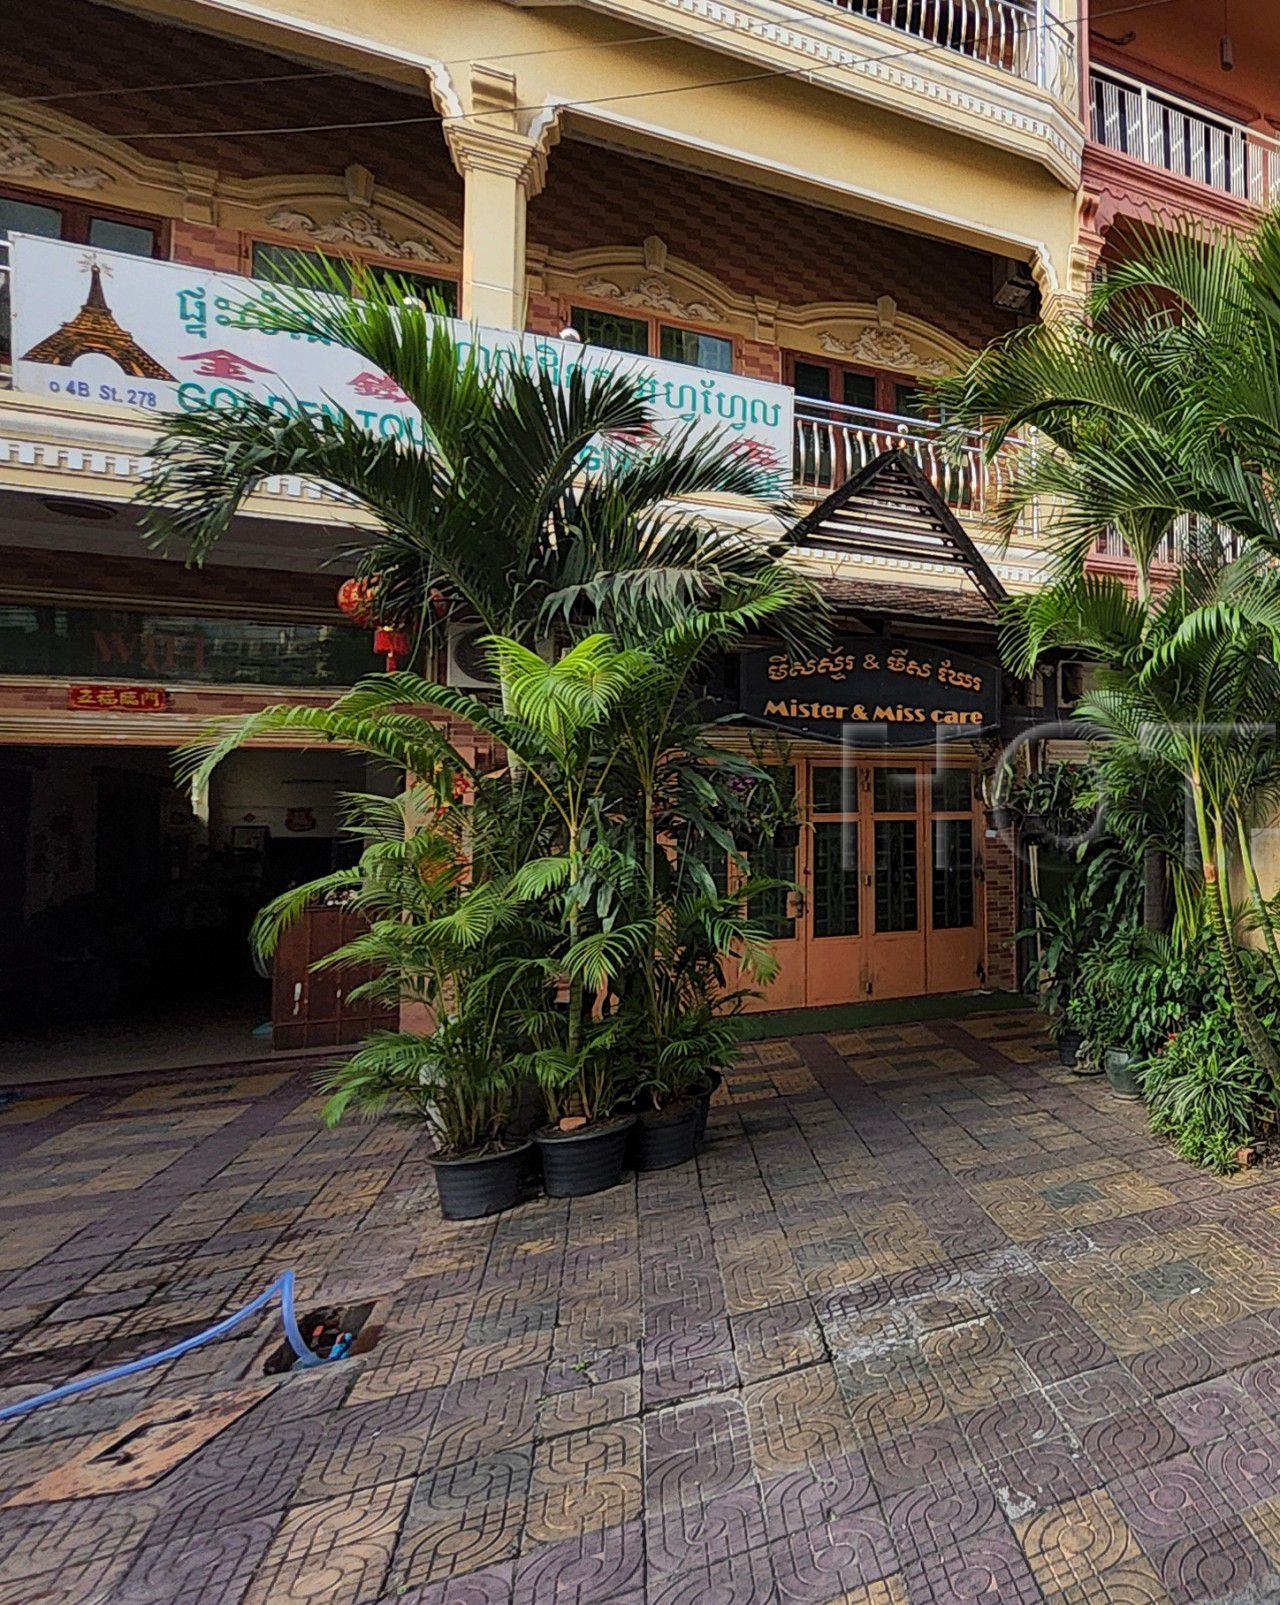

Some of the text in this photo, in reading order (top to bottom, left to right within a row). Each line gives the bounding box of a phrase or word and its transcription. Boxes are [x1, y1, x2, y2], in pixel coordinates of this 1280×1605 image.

[177, 349, 278, 382] 金
[66, 380, 90, 397] 4B
[127, 389, 157, 407] 278
[863, 654, 880, 670] &
[763, 699, 983, 725] Mister & Miss care
